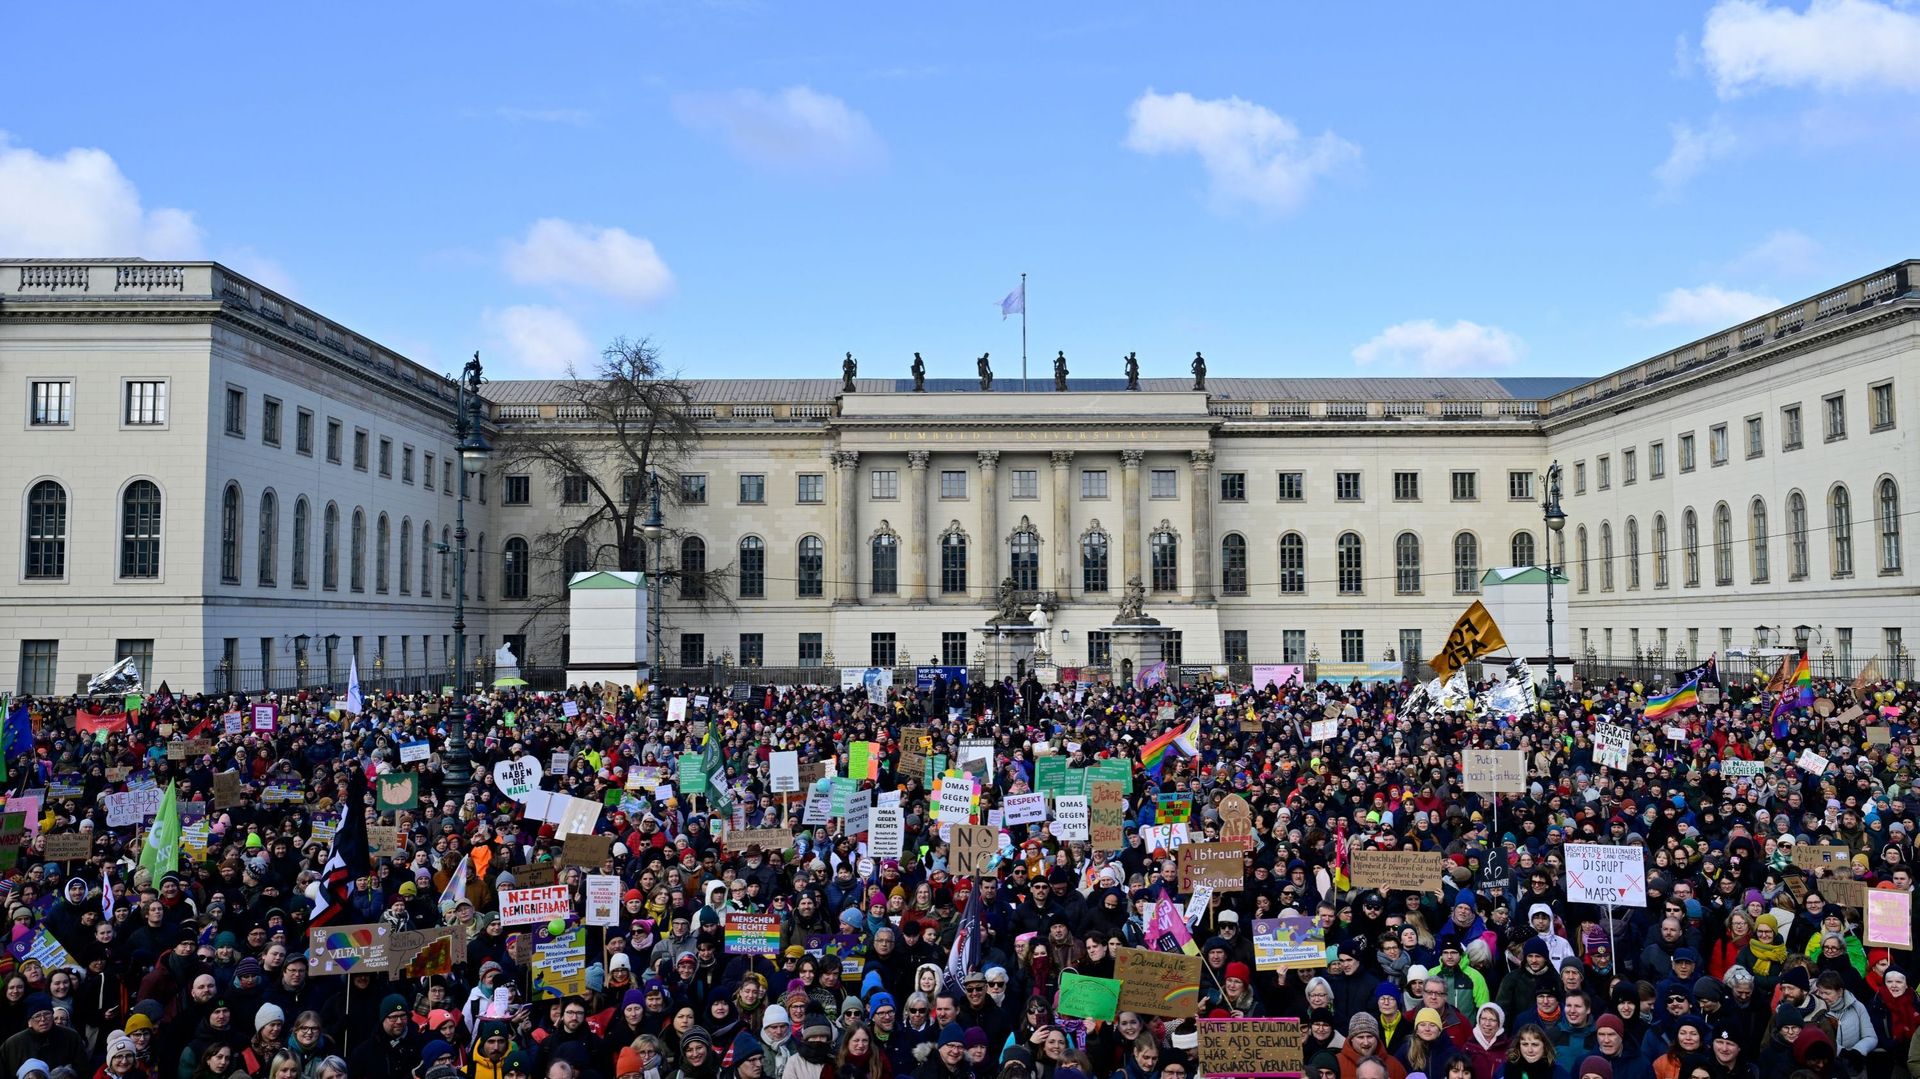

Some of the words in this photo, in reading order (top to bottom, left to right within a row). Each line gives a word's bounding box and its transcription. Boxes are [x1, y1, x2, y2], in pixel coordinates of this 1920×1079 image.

[1596, 721, 1630, 741] SEPARATE
[1601, 734, 1623, 749] TRASH
[1475, 755, 1499, 765] Putin
[509, 762, 525, 772] WIR
[1722, 766, 1764, 775] ABSCHIEBEN
[502, 768, 533, 780] HABEN
[512, 776, 526, 786] DIE
[945, 782, 970, 791] OMAS
[851, 796, 867, 804] OMAS
[942, 794, 970, 803] GEGEN
[1007, 796, 1040, 806] RESPEKT
[113, 806, 124, 815] IST
[849, 805, 868, 814] GEGEN
[939, 804, 970, 814] RECHTS
[848, 814, 868, 823] RECHTS
[1153, 826, 1180, 838] FCK
[1155, 837, 1183, 848] AFD
[1184, 848, 1243, 861] Albtraum
[1353, 853, 1369, 862] Weil
[1583, 860, 1624, 873] DISRUPT
[1183, 878, 1244, 890] Deutschland
[1598, 875, 1612, 885] ON
[508, 887, 568, 904] NICHT
[502, 900, 569, 918] REMIGRIERBAR!
[731, 915, 775, 924] MENSCHEN
[537, 943, 568, 951] Menschlich.
[731, 945, 776, 953] MENSCHEN
[545, 949, 580, 959] Miteinander.
[542, 960, 552, 968] Für
[553, 961, 582, 971] gerechtere
[1131, 954, 1187, 971] Demokratie
[1200, 1021, 1226, 1034] HÄTTE
[1230, 1021, 1250, 1033] DIE
[1252, 1020, 1300, 1033] EVOLUTION
[1203, 1036, 1222, 1048] DIE
[1255, 1035, 1300, 1050] GEWOLLT,
[1241, 1048, 1265, 1060] SIE
[1260, 1059, 1304, 1073] VERLAUFEN
